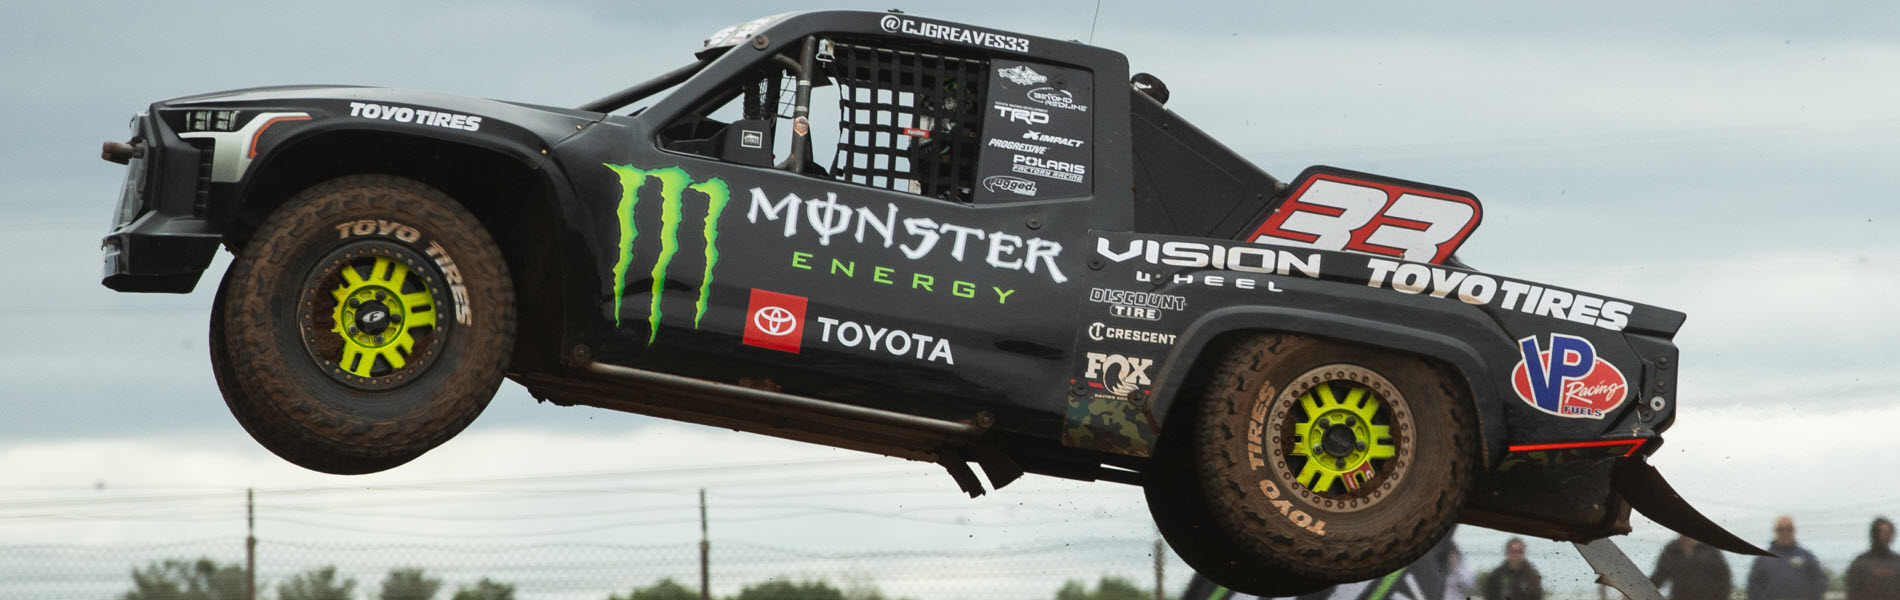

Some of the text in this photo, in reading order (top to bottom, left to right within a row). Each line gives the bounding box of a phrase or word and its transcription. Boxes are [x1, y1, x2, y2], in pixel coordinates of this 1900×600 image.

[880, 15, 1029, 52] @CJGREAVES33
[350, 102, 482, 132] TOYO TIRES
[994, 105, 1050, 125] TRD
[988, 138, 1049, 155] PROGRESSIVE
[1040, 133, 1084, 148] IMPACT
[1013, 154, 1086, 174] POLARIS
[336, 219, 421, 243] TOYO
[1254, 178, 1475, 266] 33
[1096, 237, 1321, 278] VISION
[425, 240, 472, 327] TIRES
[792, 251, 1015, 304] ENERGY
[1090, 288, 1186, 311] DISCOUNT
[1368, 258, 1634, 331] TOYO TIRES
[1114, 305, 1156, 319] TIRE
[818, 316, 954, 365] TOYOTA
[1106, 328, 1177, 345] CRESCENT
[1085, 352, 1153, 394] FOX
[1520, 335, 1595, 413] VP
[1565, 380, 1625, 405] Racing
[1248, 380, 1277, 471] TIRES
[1563, 406, 1602, 417] FUELS
[1259, 479, 1326, 536] TOYO
